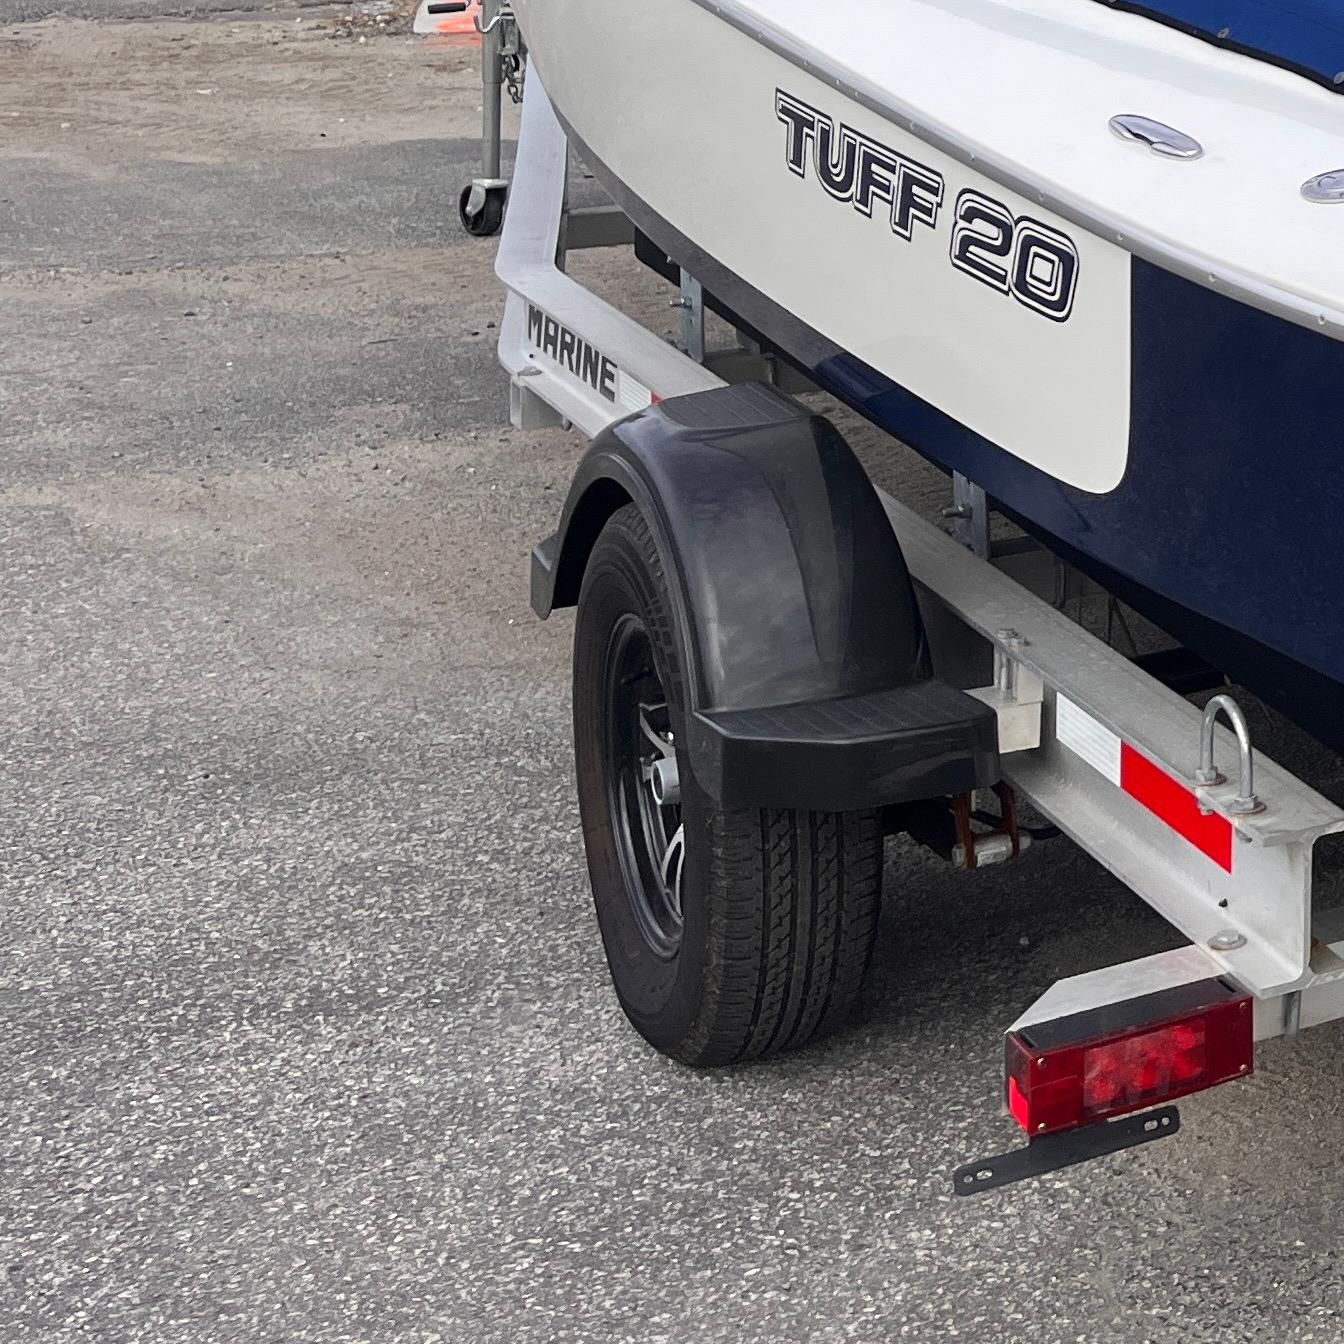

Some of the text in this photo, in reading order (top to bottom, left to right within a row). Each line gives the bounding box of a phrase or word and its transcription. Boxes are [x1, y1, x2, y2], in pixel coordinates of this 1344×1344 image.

[775, 87, 1079, 323] TUFF 20
[528, 304, 618, 404] MARINE
